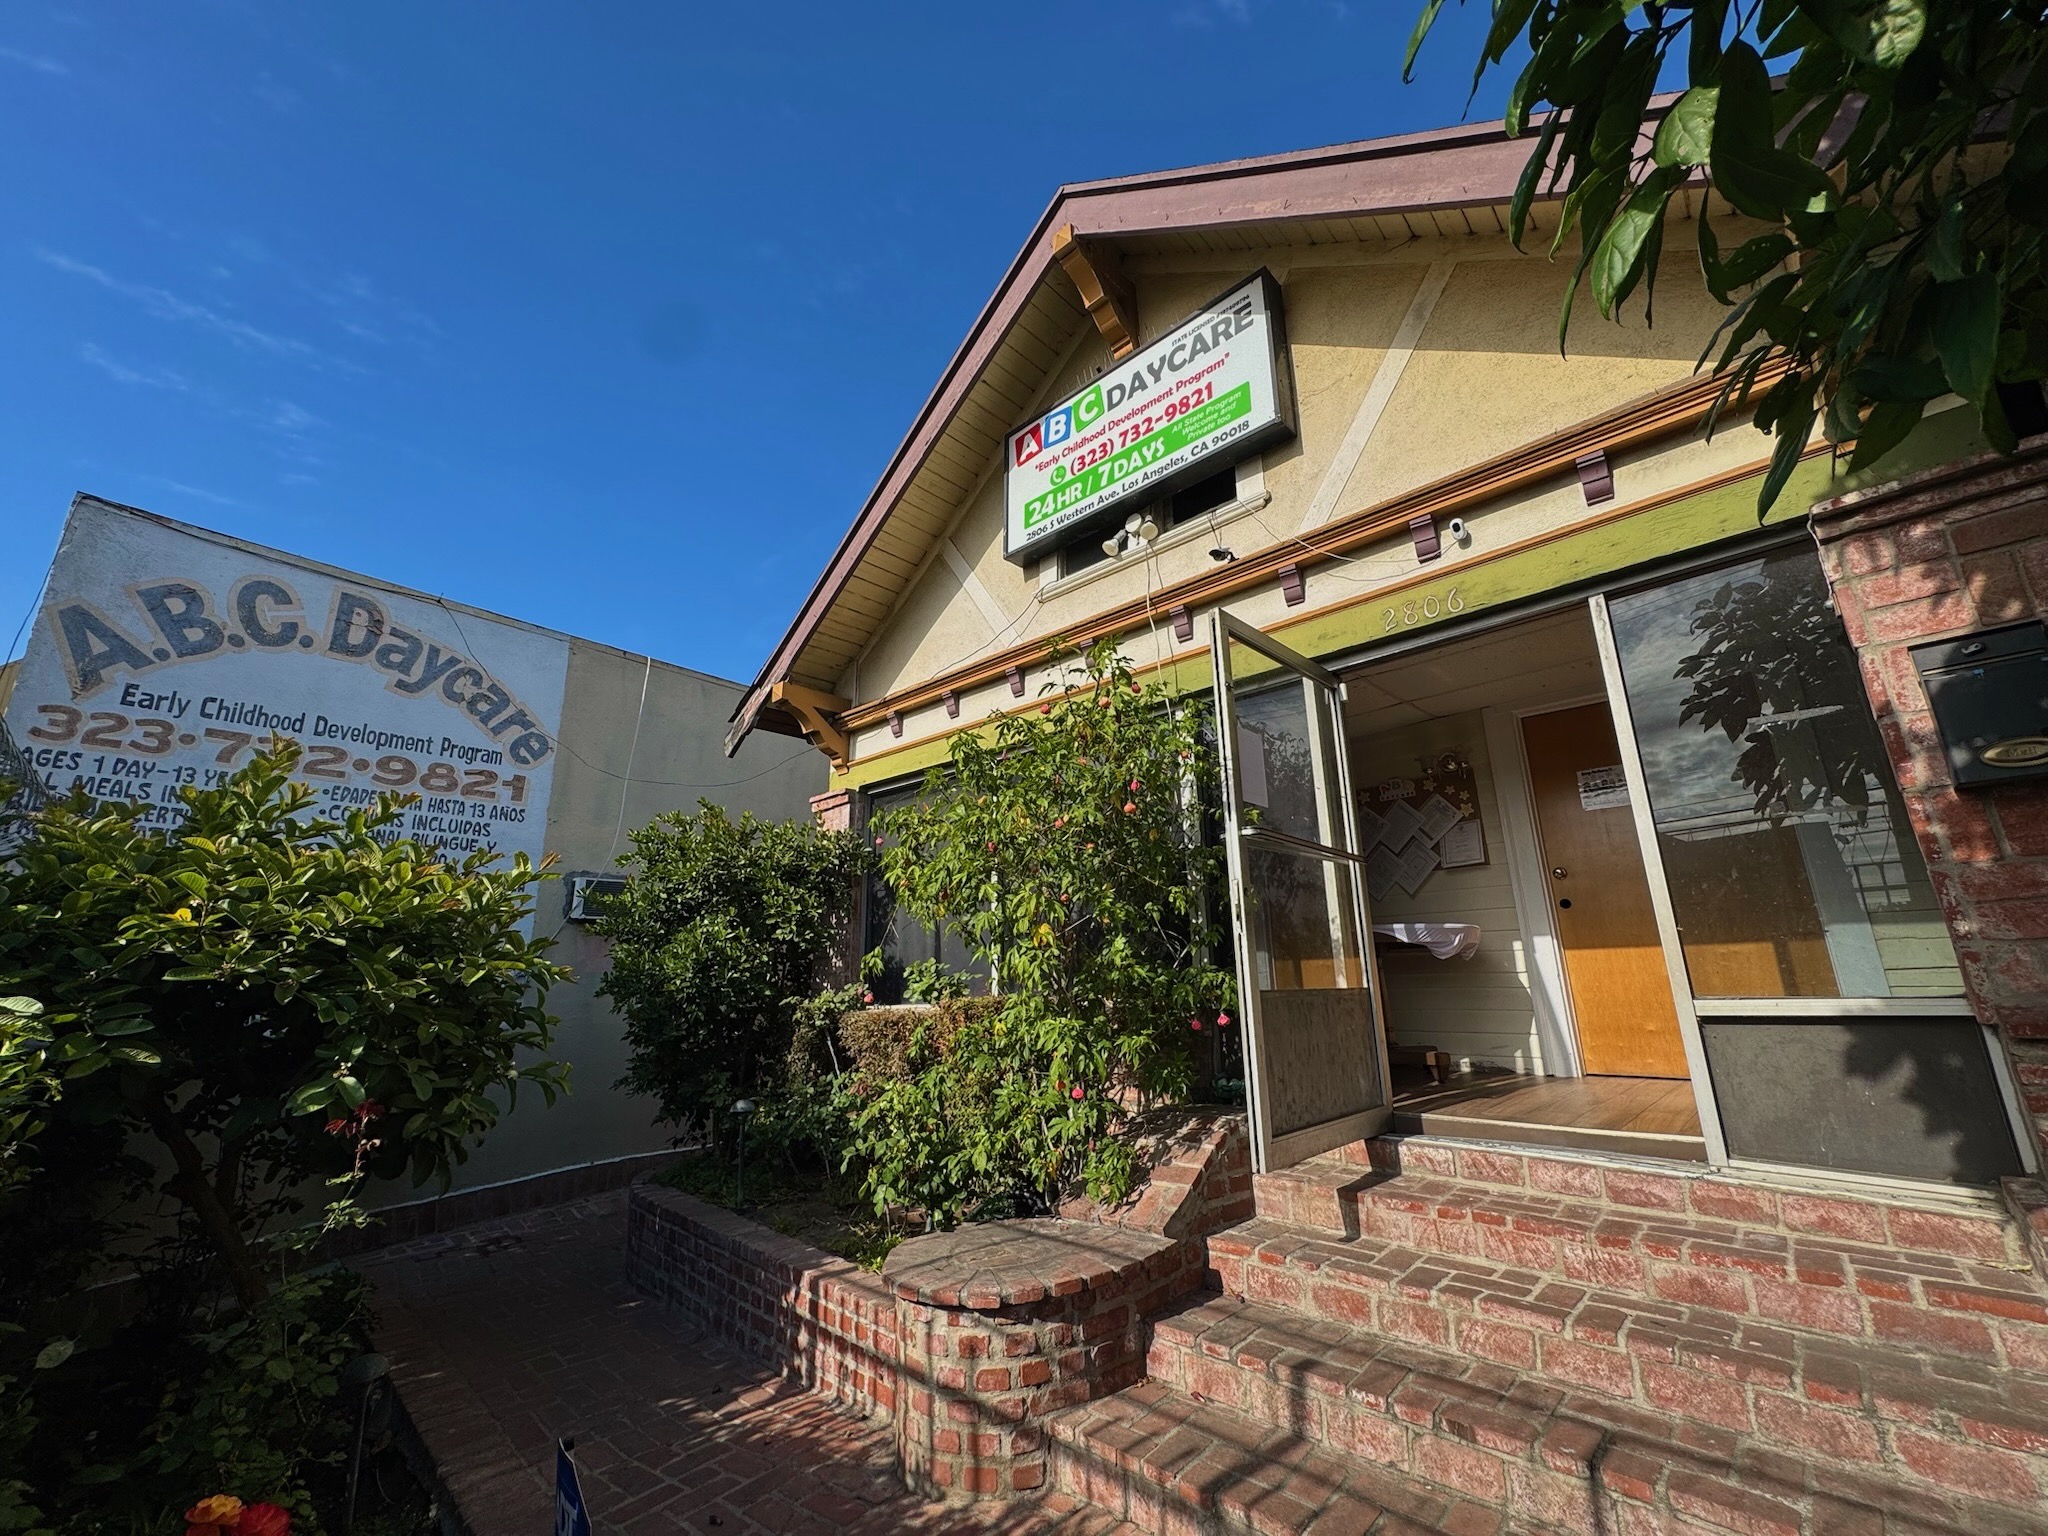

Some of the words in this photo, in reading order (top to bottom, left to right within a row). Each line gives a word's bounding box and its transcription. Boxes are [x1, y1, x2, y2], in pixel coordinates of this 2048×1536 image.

[1171, 334, 1188, 347] STATE
[1188, 315, 1216, 336] LICENSED
[1106, 300, 1254, 412] DAYCARE
[1061, 427, 1106, 458] Childhood
[1107, 386, 1174, 432] Development
[1069, 438, 1115, 476] (323)
[1118, 381, 1213, 449] 732-9821
[1171, 423, 1183, 434] All
[1184, 410, 1205, 428] State
[1205, 391, 1242, 417] Program
[1182, 411, 1218, 436] Welcome
[1219, 401, 1237, 414] and
[1187, 421, 1216, 441] Private
[1217, 414, 1231, 426] too
[1026, 525, 1048, 542] 2806
[1049, 519, 1056, 530] S
[1056, 501, 1095, 526] Western
[1097, 489, 1120, 506] Ave.
[1121, 481, 1139, 493] Los
[1141, 455, 1189, 483] Angeles,
[1190, 441, 1210, 457] CA
[1211, 420, 1250, 448] 90018
[1382, 586, 1464, 634] 2806
[56, 579, 315, 701] A.B.C.
[327, 590, 550, 767] Daycare
[119, 682, 193, 718] Early
[199, 696, 306, 734] Childhood
[313, 715, 434, 755] Development
[440, 736, 504, 766] Program
[93, 755, 106, 774] 1
[72, 774, 153, 800] MEALS
[411, 814, 491, 837] INCLUIDAS
[427, 797, 466, 816] HASTA
[469, 803, 486, 818] 13
[489, 805, 526, 823] AÑOS
